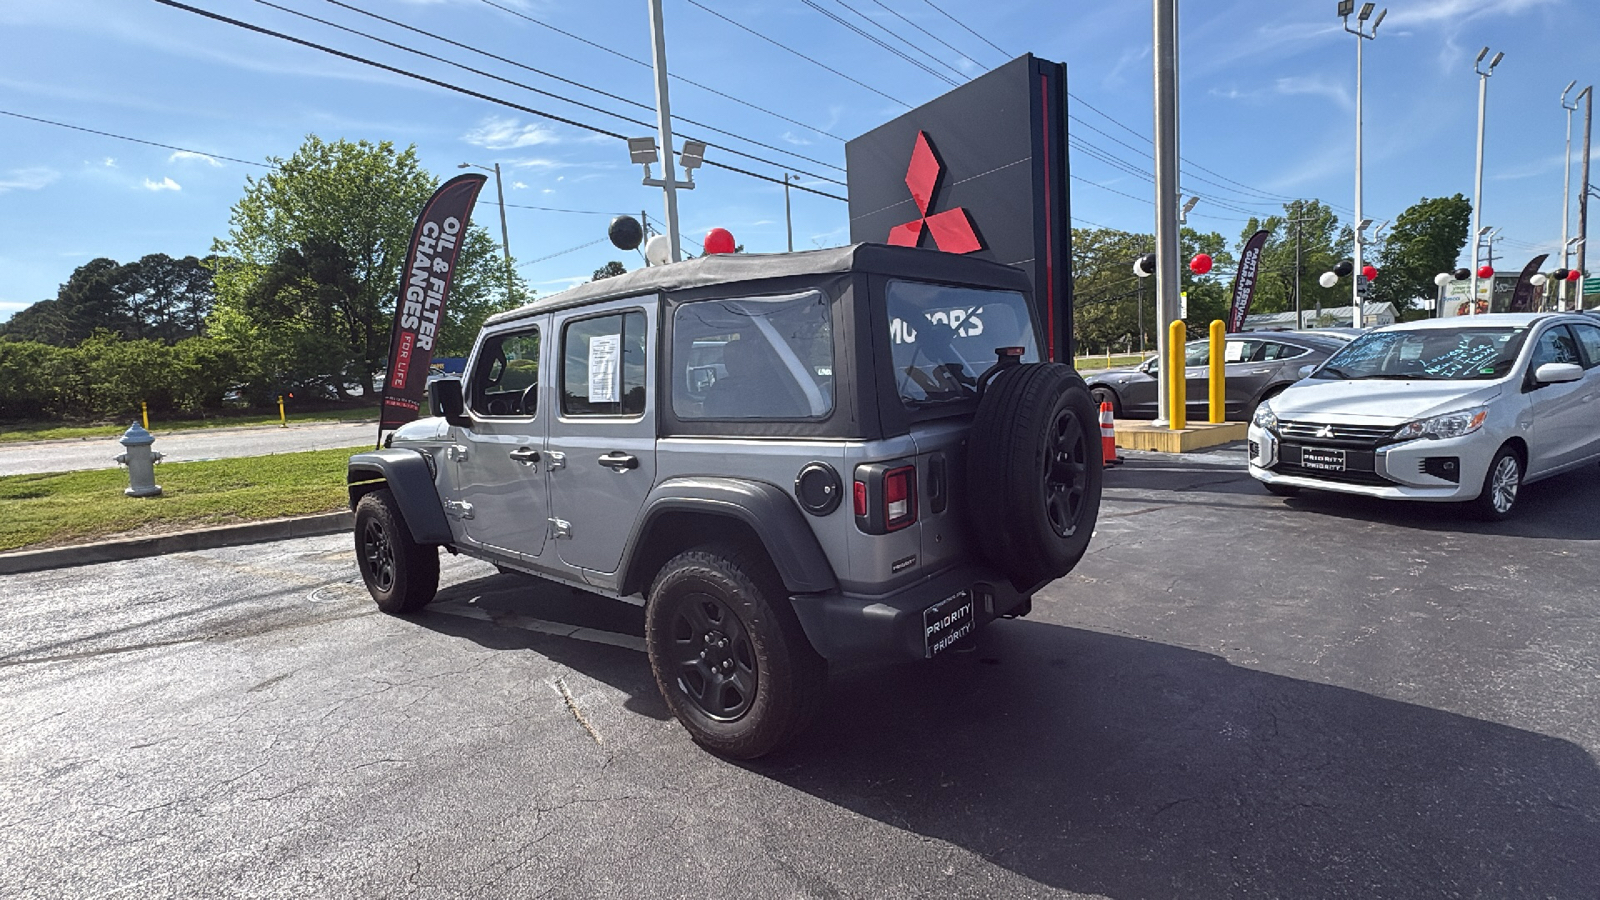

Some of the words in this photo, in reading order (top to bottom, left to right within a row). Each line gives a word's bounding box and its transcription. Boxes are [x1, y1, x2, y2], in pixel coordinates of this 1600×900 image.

[436, 217, 461, 252] OIL
[401, 221, 440, 330] CHANGES
[432, 257, 449, 274] &
[1247, 247, 1259, 278] PARTS
[416, 277, 446, 351] FILTER
[1236, 287, 1251, 328] SERVICE
[889, 306, 984, 344] MOORS
[399, 335, 412, 358] FOR
[394, 361, 407, 386] LIFE
[926, 603, 971, 637] PRIORITY
[933, 622, 971, 654] PRIORITY
